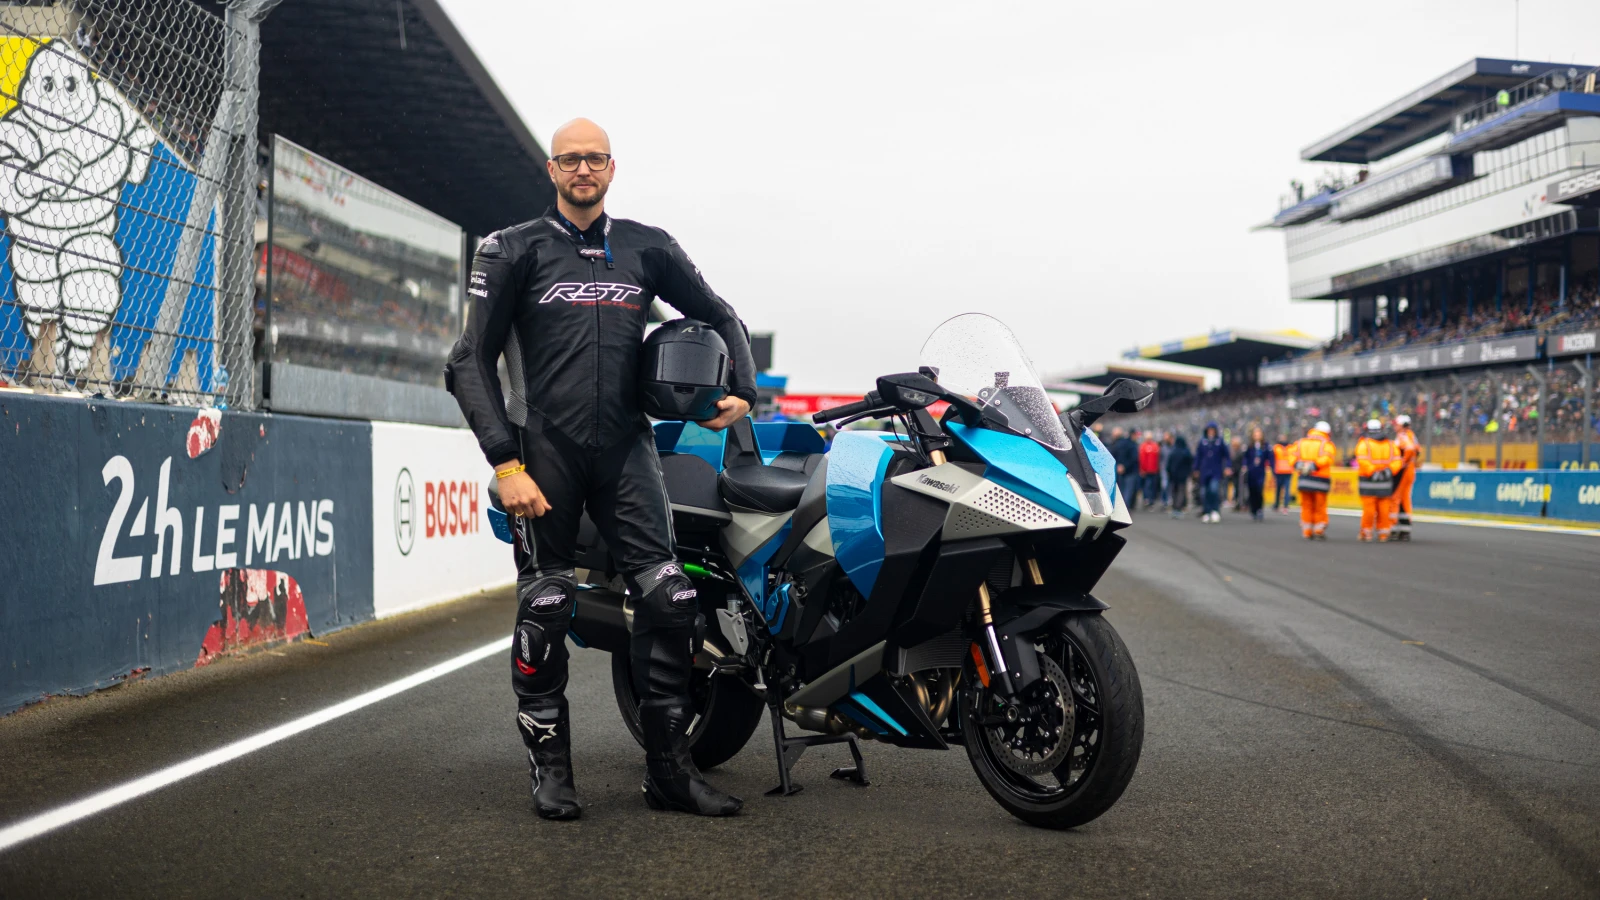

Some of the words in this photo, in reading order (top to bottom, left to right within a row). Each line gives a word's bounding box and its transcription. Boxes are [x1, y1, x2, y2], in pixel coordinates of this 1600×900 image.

[538, 281, 642, 303] RST
[916, 473, 960, 494] Kawasaki
[425, 480, 478, 538] BOSCH
[93, 455, 183, 586] 24h
[191, 504, 240, 573] LE
[245, 498, 334, 566] MANS
[530, 595, 566, 607] RST
